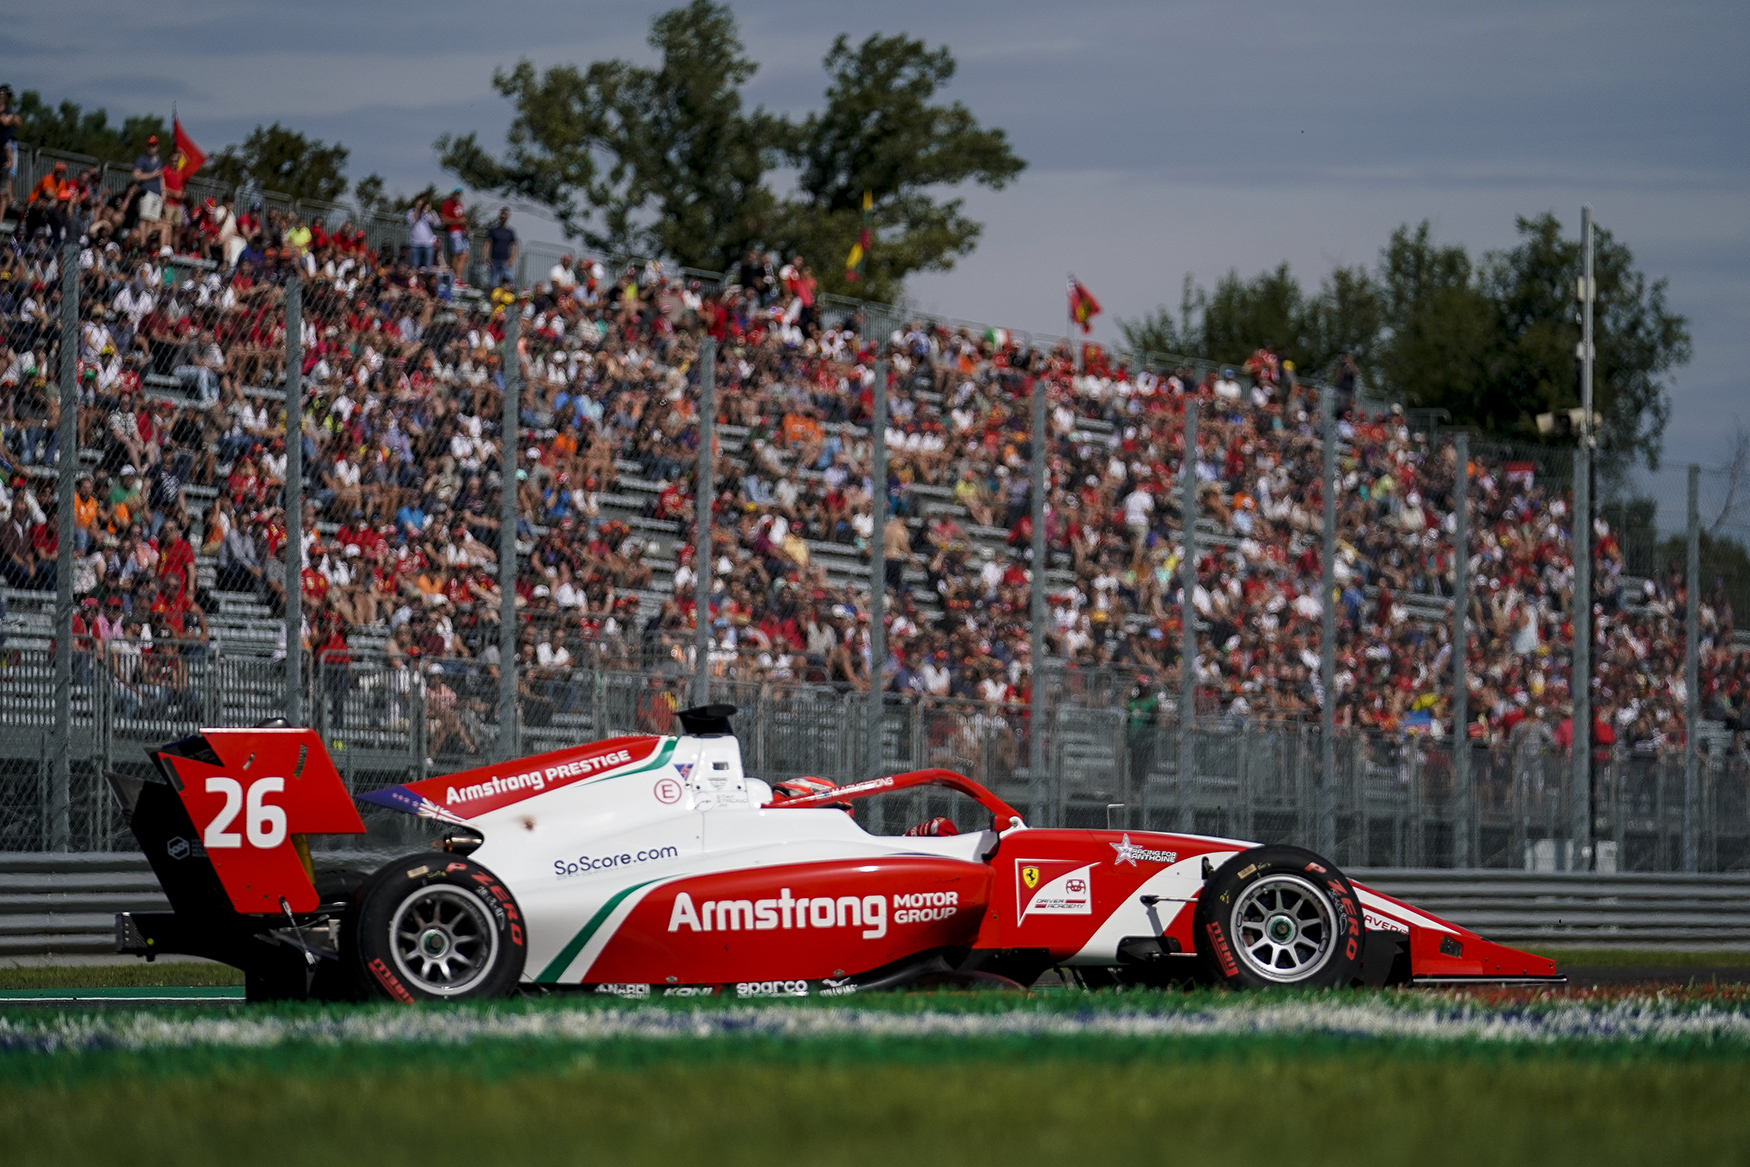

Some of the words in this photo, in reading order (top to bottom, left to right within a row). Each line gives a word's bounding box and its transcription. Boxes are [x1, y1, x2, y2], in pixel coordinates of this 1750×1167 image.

[446, 771, 544, 805] Armstrong
[546, 750, 631, 781] PRESTIGE
[662, 784, 675, 799] E
[203, 777, 287, 849] 26
[554, 846, 678, 875] SpScore.com
[1131, 854, 1176, 863] ANTHOINE
[445, 862, 467, 873] P
[471, 871, 523, 946] ZERO
[667, 888, 887, 939] Armstrong
[893, 891, 958, 909] MOTOR
[894, 907, 957, 924] GROUP
[1304, 861, 1327, 874] P
[1327, 879, 1360, 960] ZERO
[1206, 921, 1239, 977] PIRELLI
[736, 980, 809, 996] sparco
